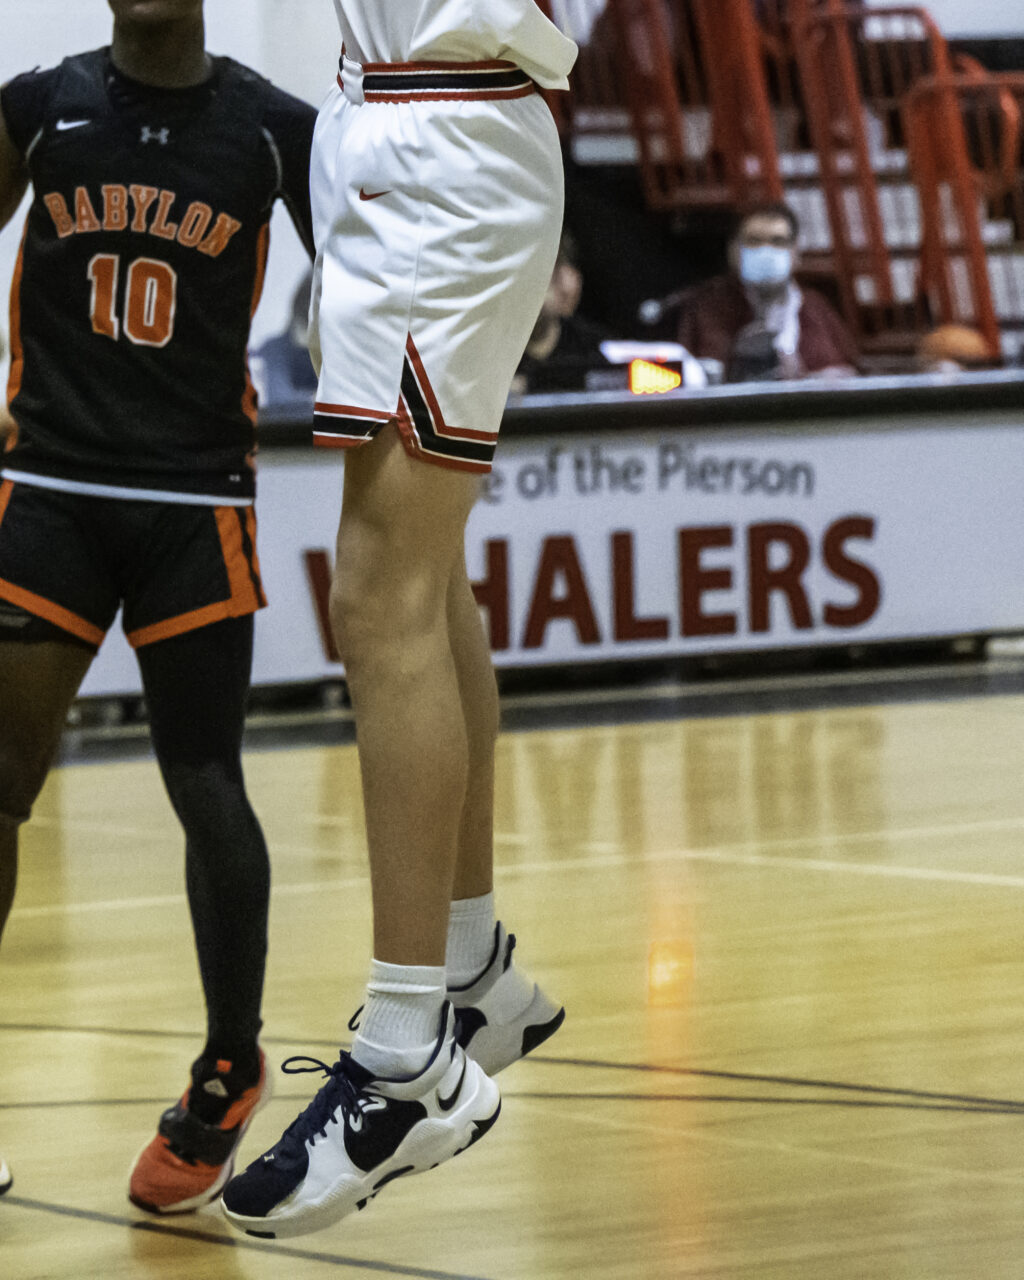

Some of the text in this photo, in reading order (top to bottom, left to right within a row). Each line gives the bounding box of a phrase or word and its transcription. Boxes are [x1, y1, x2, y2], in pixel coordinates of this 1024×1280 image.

[43, 183, 243, 258] BABYLON
[87, 253, 178, 348] 10
[516, 447, 560, 500] of
[573, 444, 646, 498] the
[655, 442, 816, 497] Pierson
